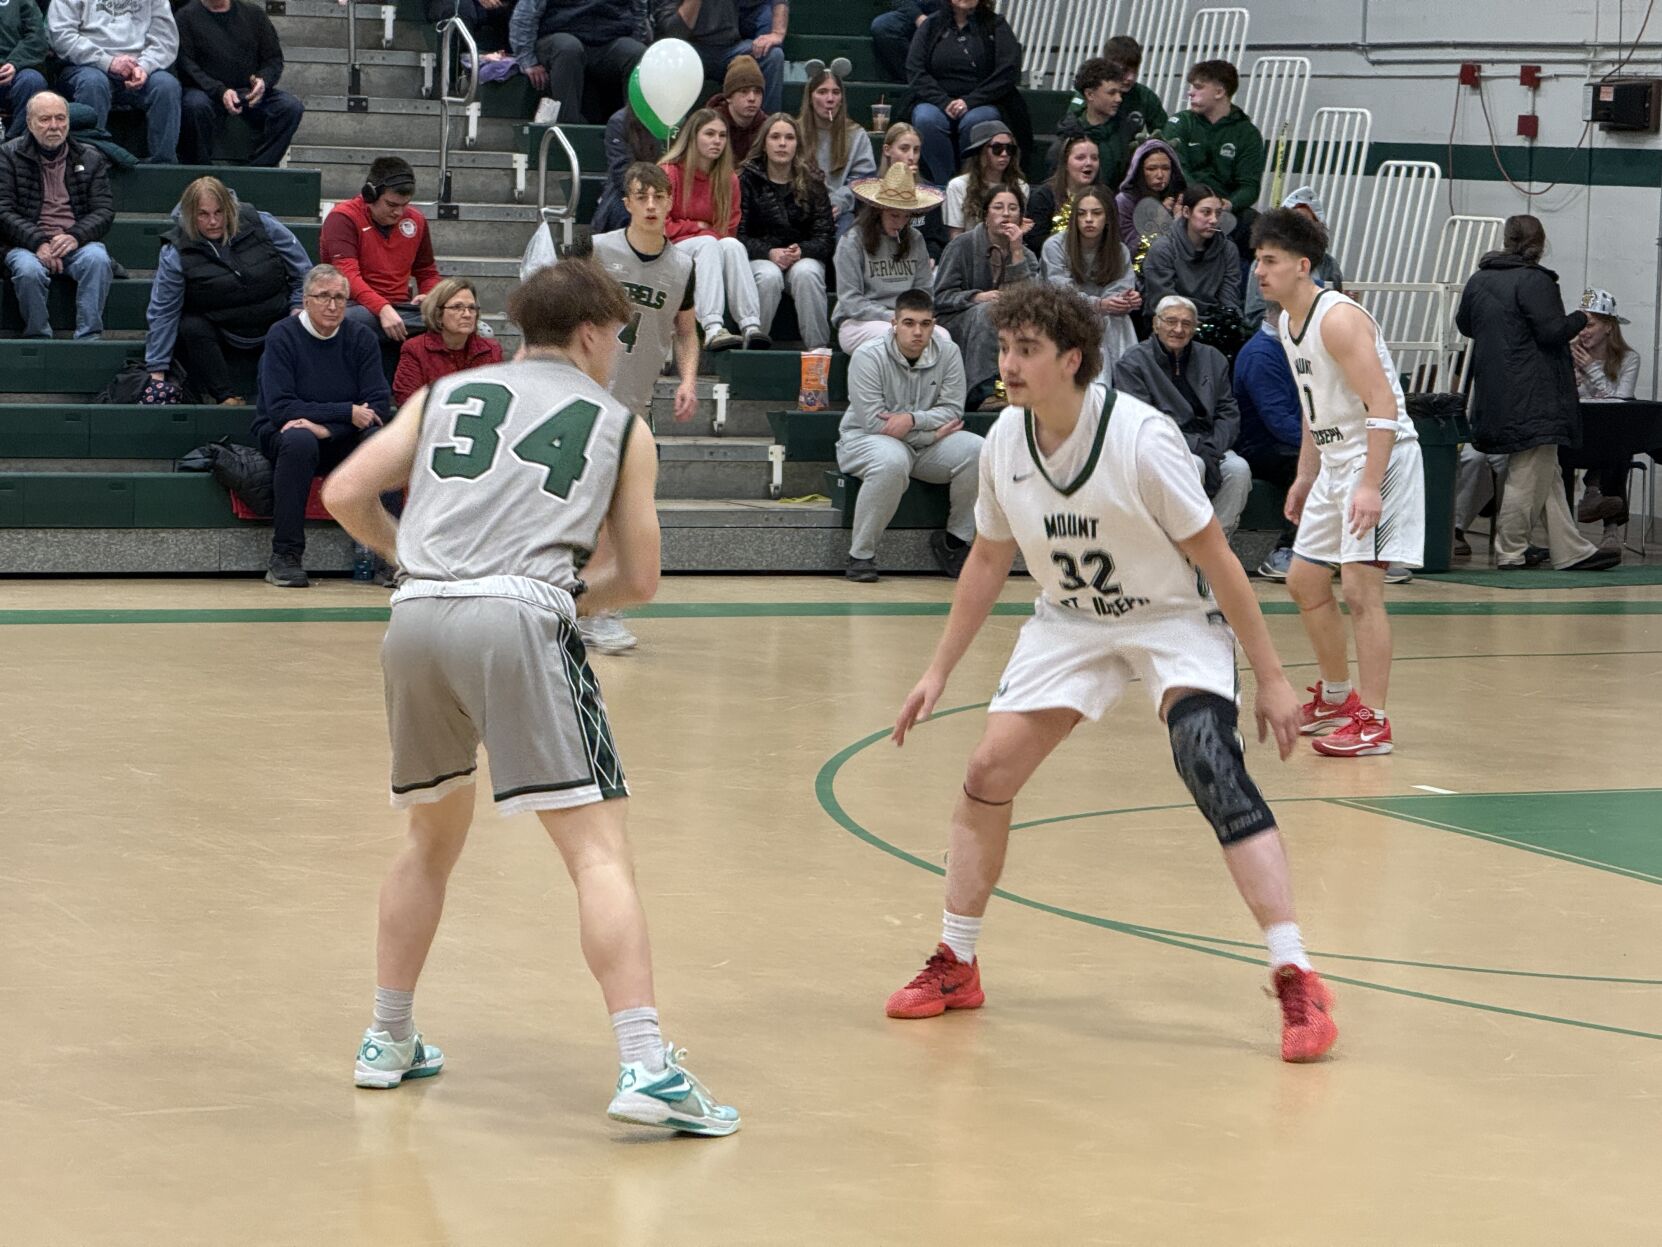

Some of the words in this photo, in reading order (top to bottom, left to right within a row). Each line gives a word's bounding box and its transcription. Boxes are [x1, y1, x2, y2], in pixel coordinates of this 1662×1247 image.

[869, 260, 917, 278] VERMONT
[616, 311, 641, 354] 4
[428, 379, 608, 503] 34
[1043, 513, 1099, 539] MOUNT
[1050, 549, 1122, 595] 32
